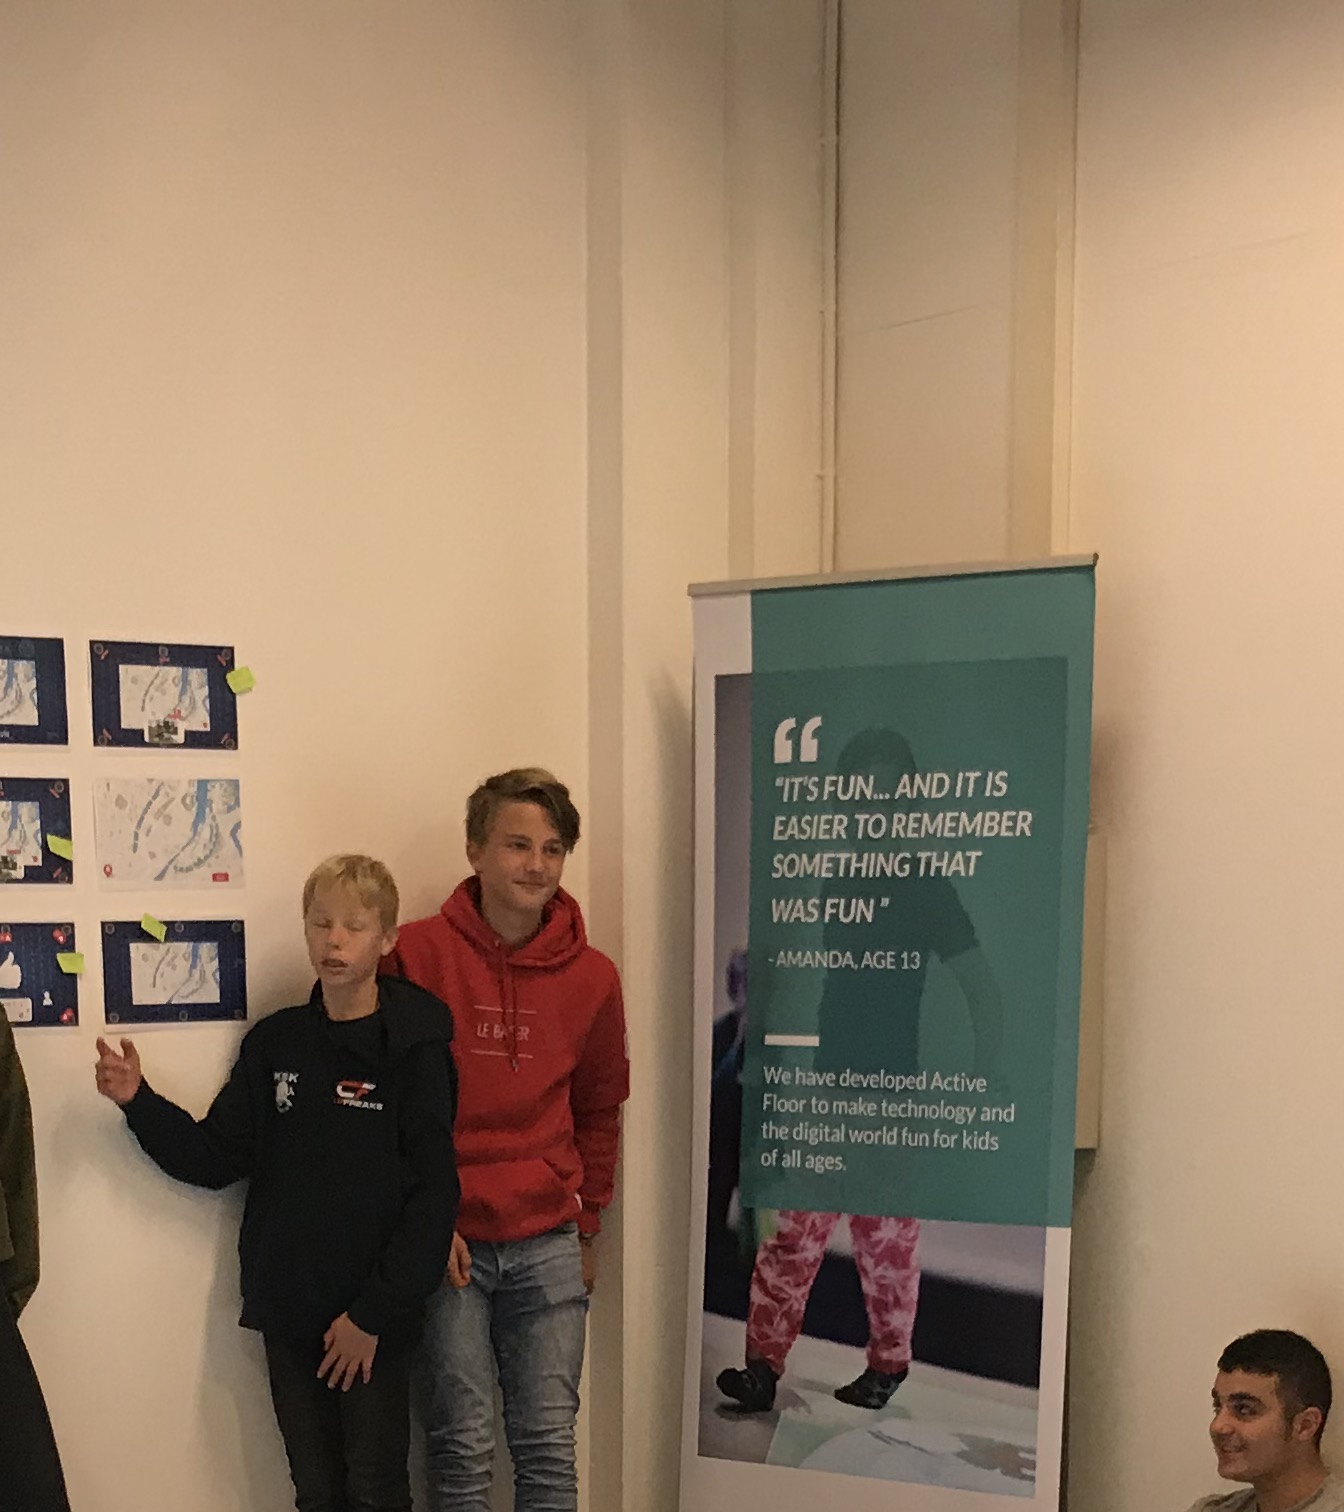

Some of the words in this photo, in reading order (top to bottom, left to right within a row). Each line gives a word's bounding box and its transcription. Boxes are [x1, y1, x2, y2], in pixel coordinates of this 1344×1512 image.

[895, 771, 950, 799] AND
[955, 771, 982, 798] IT
[986, 770, 1009, 797] IS
[773, 813, 848, 840] EASIER
[856, 812, 887, 839] TO
[891, 811, 1033, 839] REMEMBER
[771, 852, 912, 879] SOMETHING
[917, 850, 983, 877] THAT
[771, 898, 819, 923] WAS
[824, 898, 875, 923] FUN
[861, 950, 896, 970] AGE
[901, 950, 921, 970] 13
[763, 1066, 791, 1085] We
[795, 1066, 836, 1088] have
[839, 1067, 927, 1093] developed
[930, 1071, 988, 1093] Active
[762, 1093, 807, 1113] Floor
[810, 1096, 829, 1114] to
[832, 1095, 877, 1118] make
[880, 1098, 977, 1124] technology
[980, 1102, 1016, 1123] and
[761, 1121, 788, 1141] the
[792, 1122, 846, 1146] digital
[849, 1124, 898, 1146] world
[901, 1126, 930, 1147] fun
[932, 1128, 959, 1149] for
[962, 1129, 1000, 1152] kids
[761, 1148, 778, 1168] of
[781, 1149, 802, 1169] all
[805, 1152, 848, 1174] ages.
